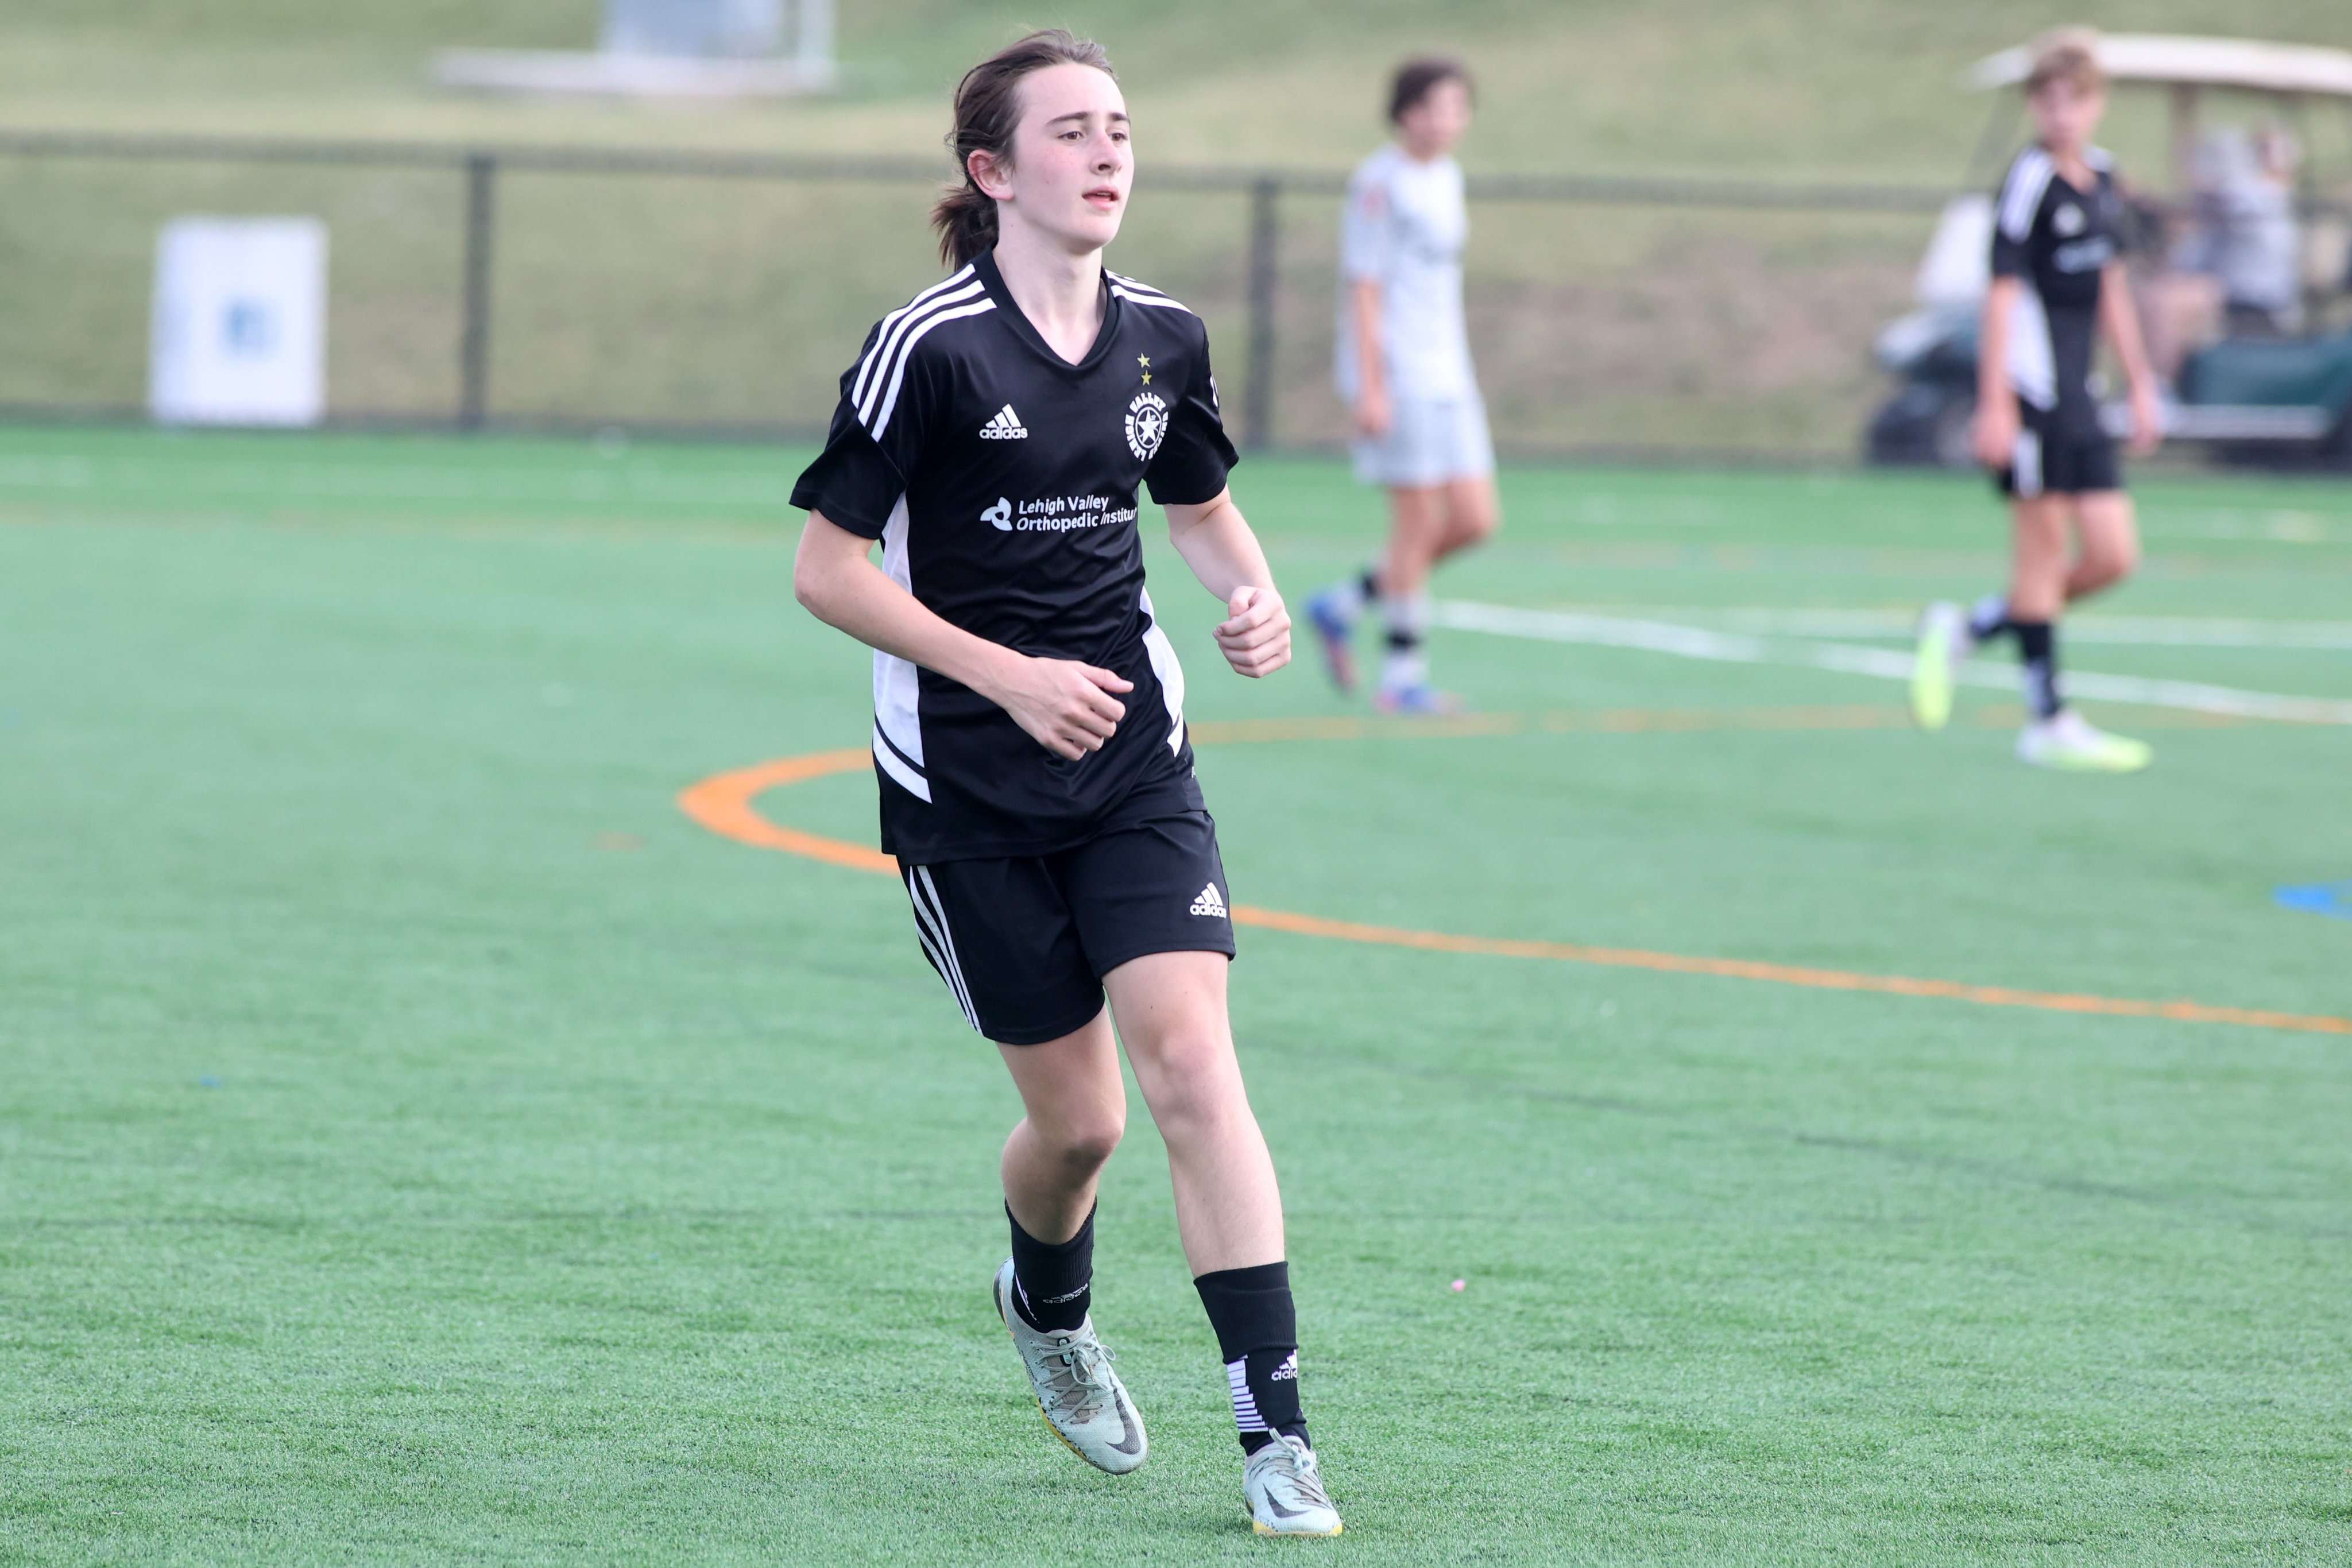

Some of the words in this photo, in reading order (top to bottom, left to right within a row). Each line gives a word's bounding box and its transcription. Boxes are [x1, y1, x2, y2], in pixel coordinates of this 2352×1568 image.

[979, 427, 1028, 440] adidas
[1019, 496, 1066, 516] Lehigh
[1067, 494, 1109, 512] Valley
[1016, 511, 1098, 533] Orthopedic
